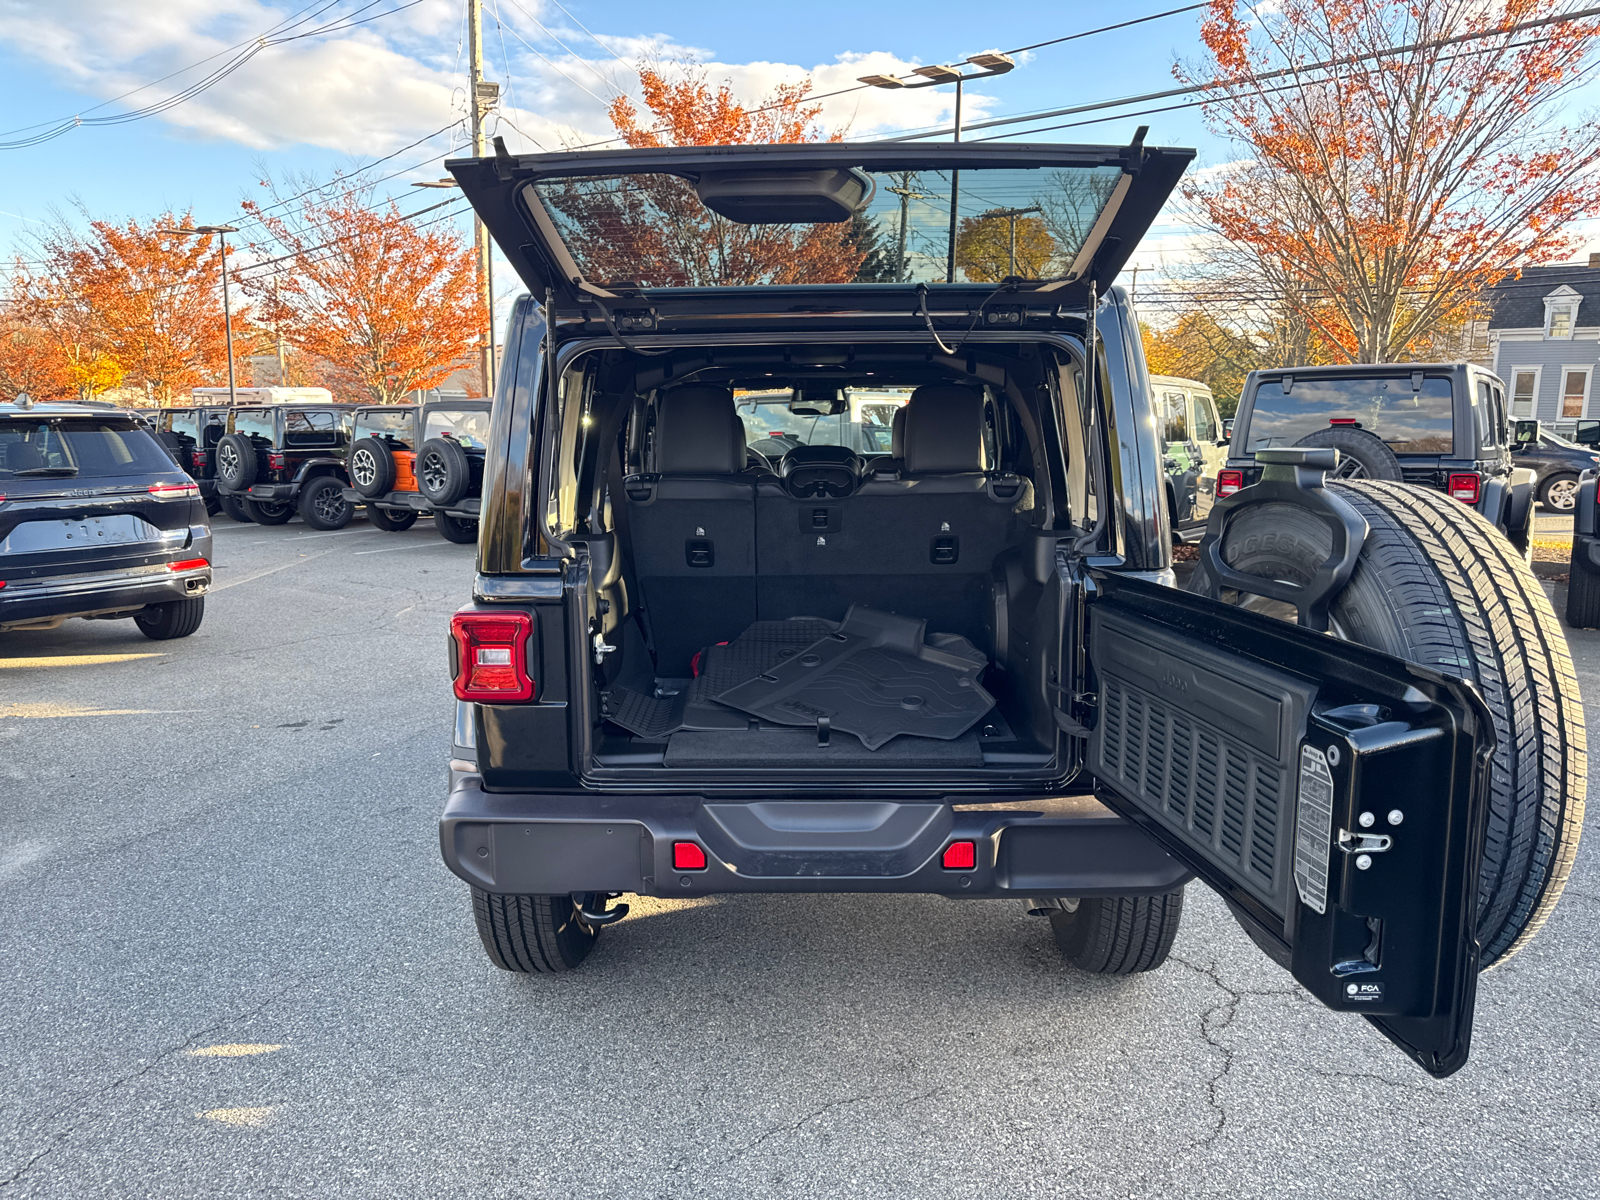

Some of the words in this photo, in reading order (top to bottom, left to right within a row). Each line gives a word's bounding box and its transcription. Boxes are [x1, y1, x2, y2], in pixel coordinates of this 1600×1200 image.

[1162, 669, 1189, 694] Jeep
[783, 700, 826, 716] Jeep
[1303, 760, 1328, 777] JL
[1309, 870, 1324, 886] USA
[1360, 984, 1380, 992] FCA
